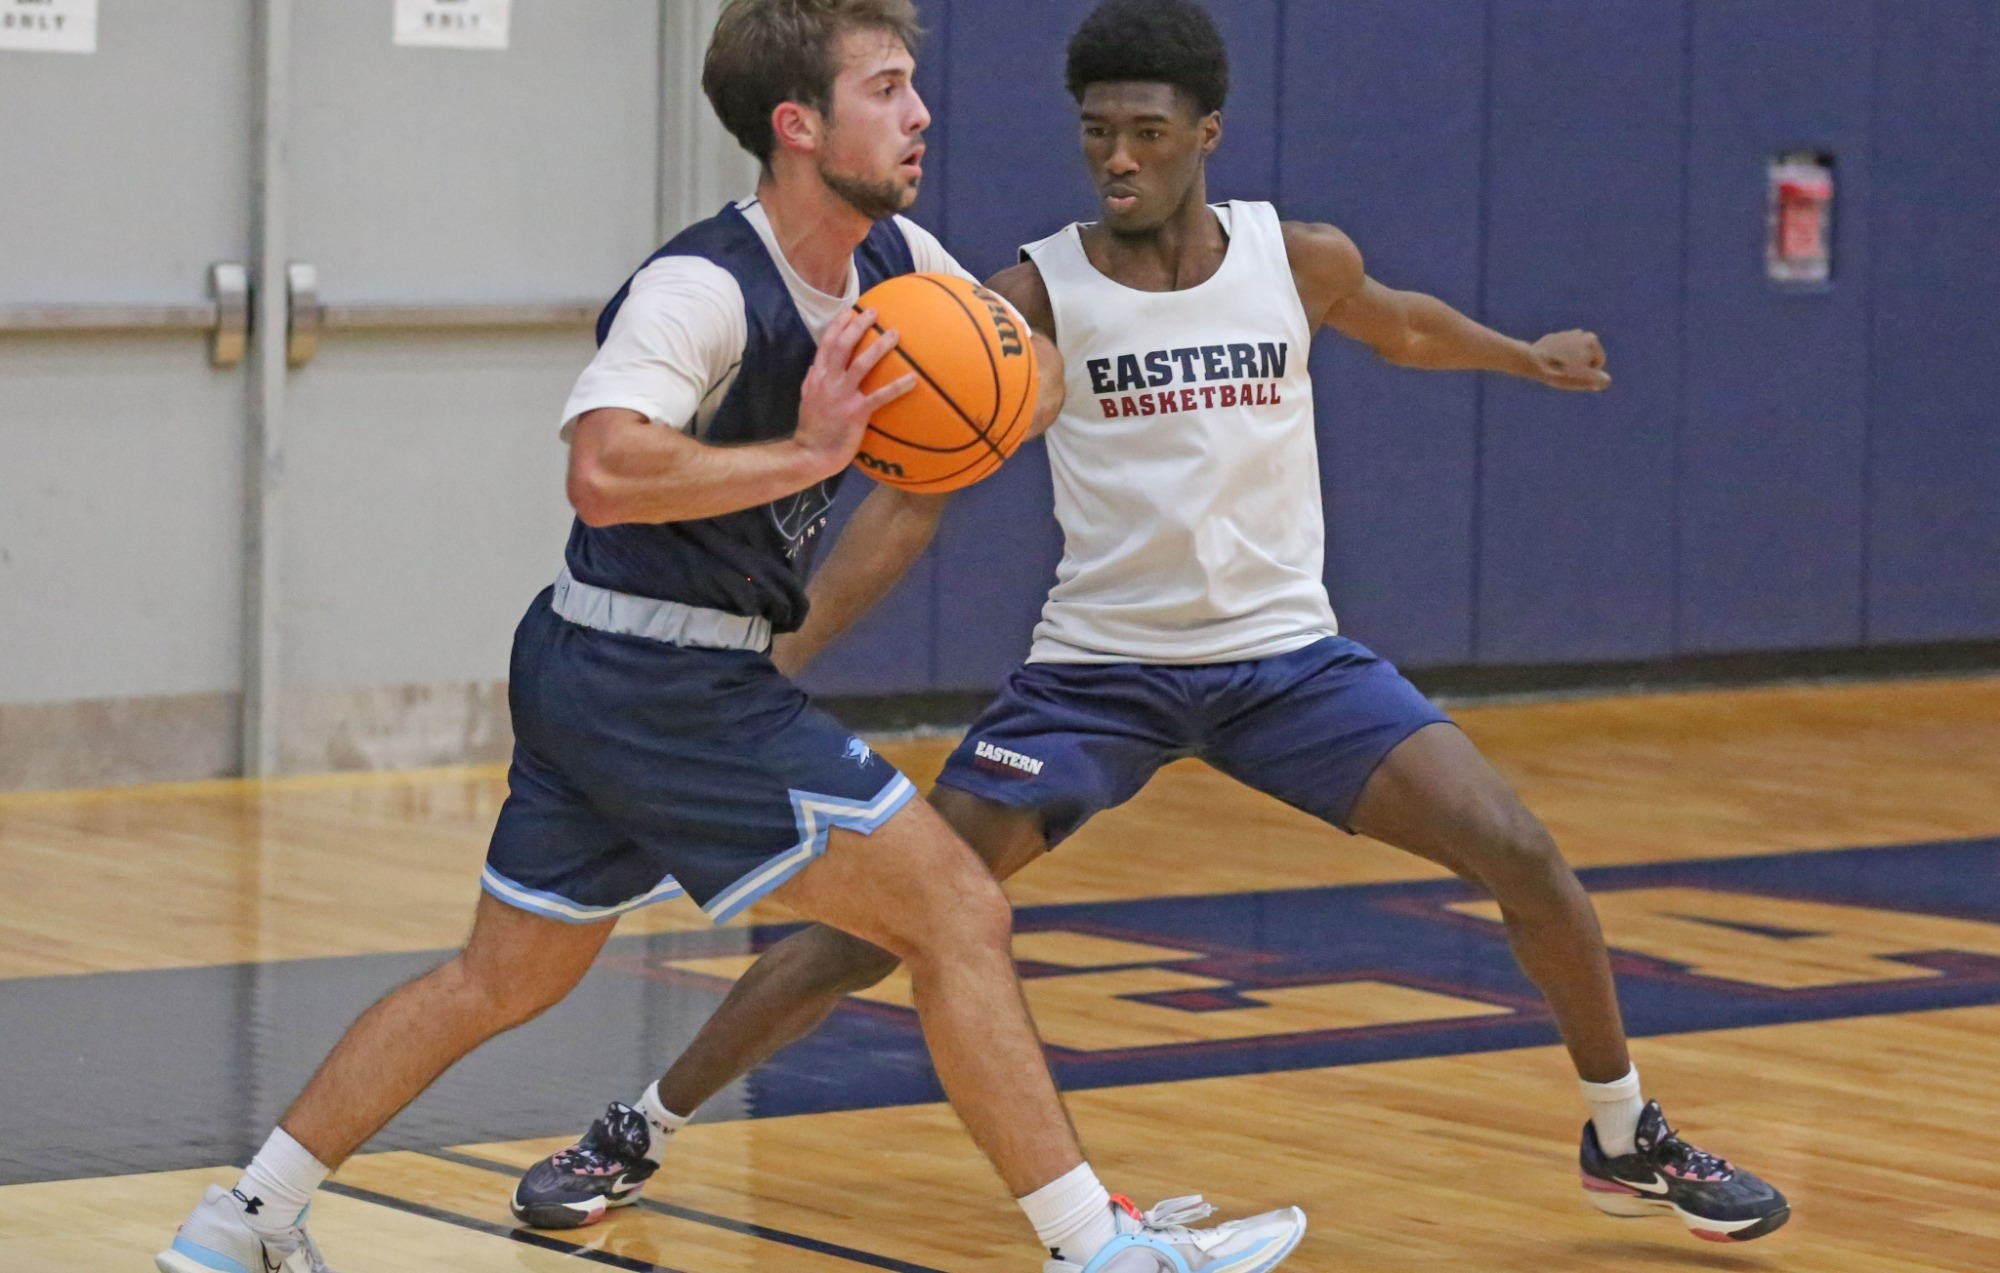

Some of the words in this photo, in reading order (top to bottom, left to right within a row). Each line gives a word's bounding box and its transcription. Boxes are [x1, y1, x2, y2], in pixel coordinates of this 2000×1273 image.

[1087, 342, 1288, 394] EASTERN
[1099, 382, 1281, 418] BASKETBALL
[975, 740, 1044, 776] EASTERN
